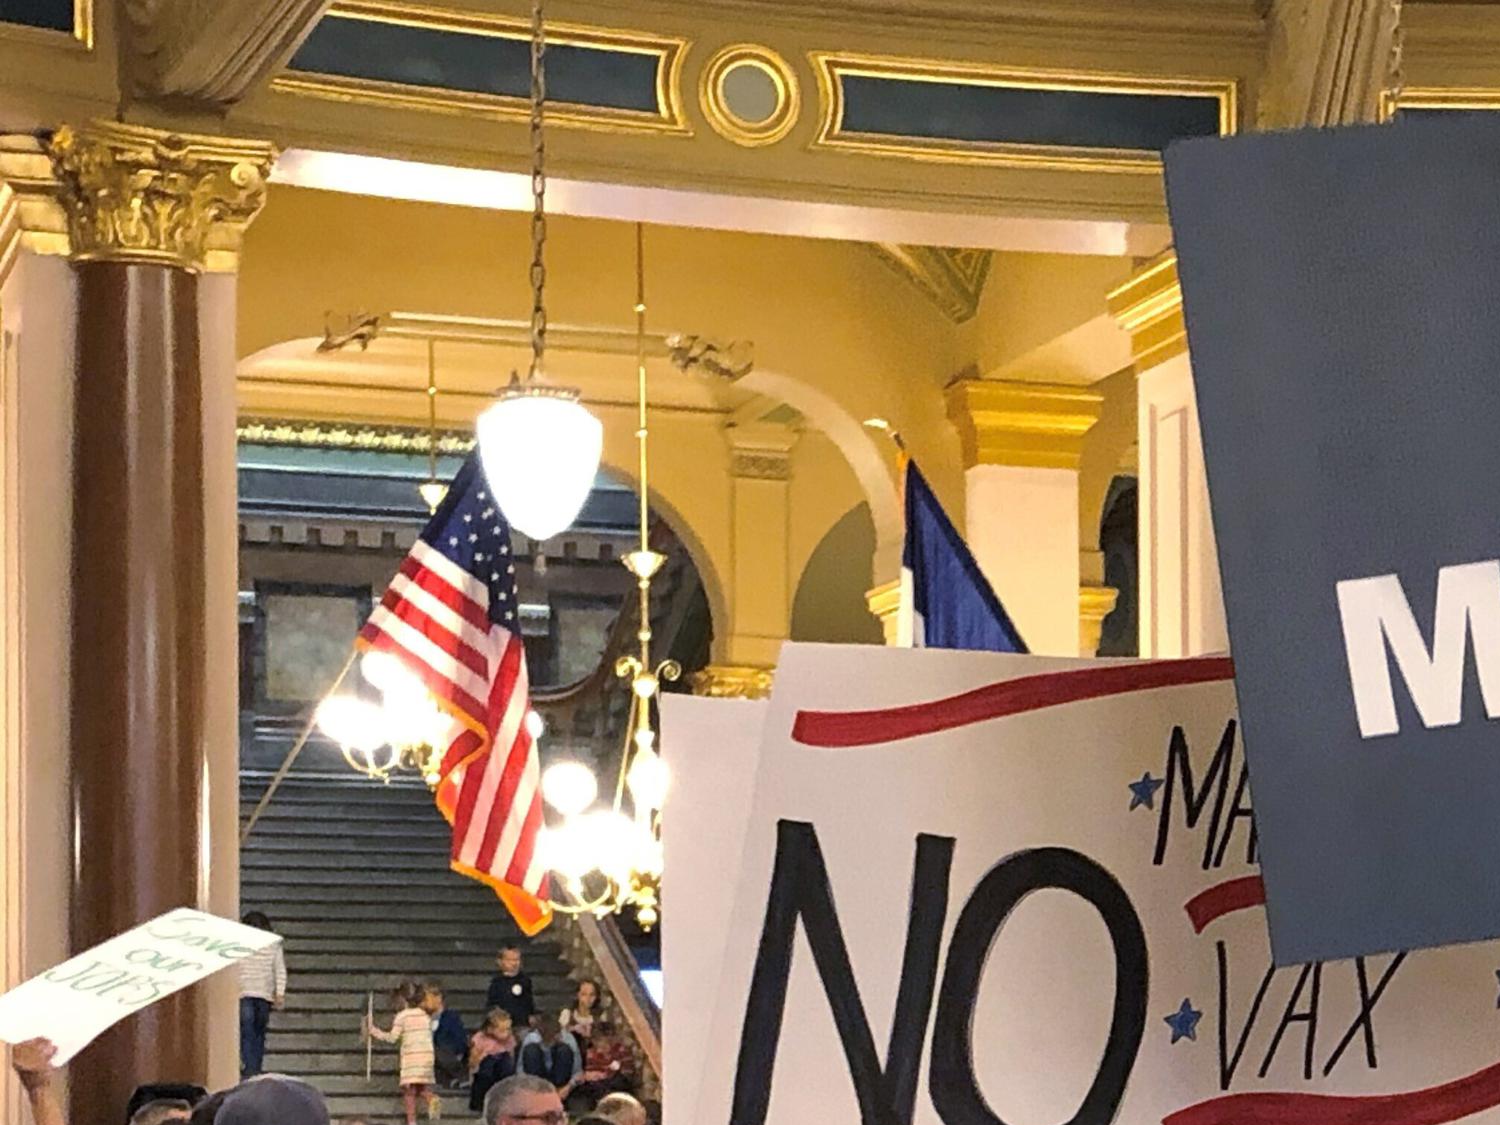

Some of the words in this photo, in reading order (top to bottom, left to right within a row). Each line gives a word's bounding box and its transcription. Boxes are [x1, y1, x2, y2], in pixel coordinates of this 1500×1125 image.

[1153, 718, 1258, 870] MA
[125, 948, 200, 971] our
[1216, 940, 1408, 1091] VAX
